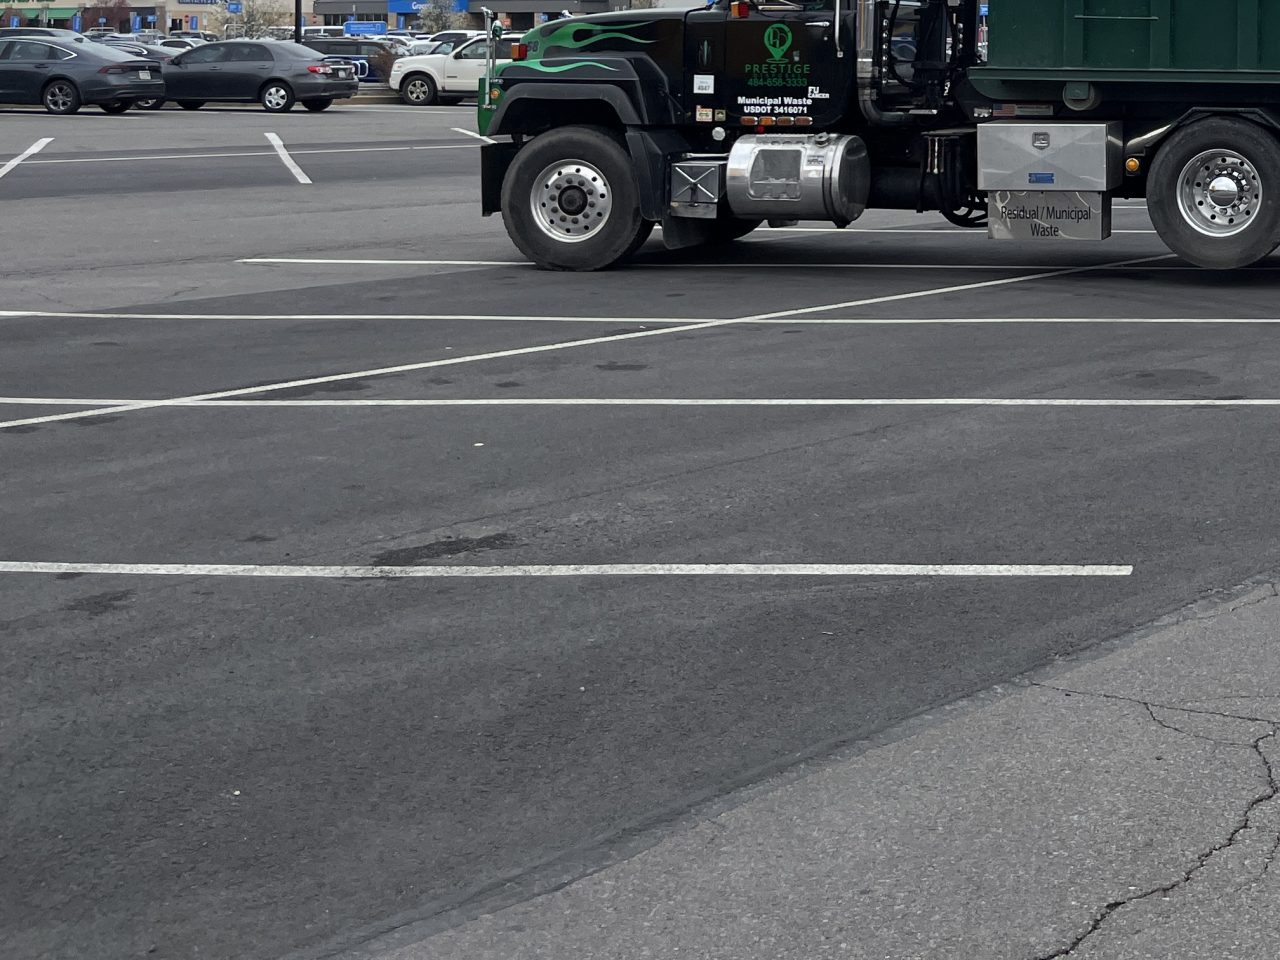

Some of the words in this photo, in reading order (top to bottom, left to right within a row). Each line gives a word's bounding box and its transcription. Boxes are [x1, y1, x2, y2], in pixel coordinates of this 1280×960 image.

[745, 64, 811, 73] PRESTIGE
[747, 78, 807, 86] 484-658-3333
[737, 96, 781, 105] Municipal
[783, 97, 813, 105] Waste
[773, 106, 807, 114] 3416071
[1001, 205, 1039, 220] Residual
[1046, 205, 1091, 223] Municipal
[1030, 223, 1059, 237] Waste
